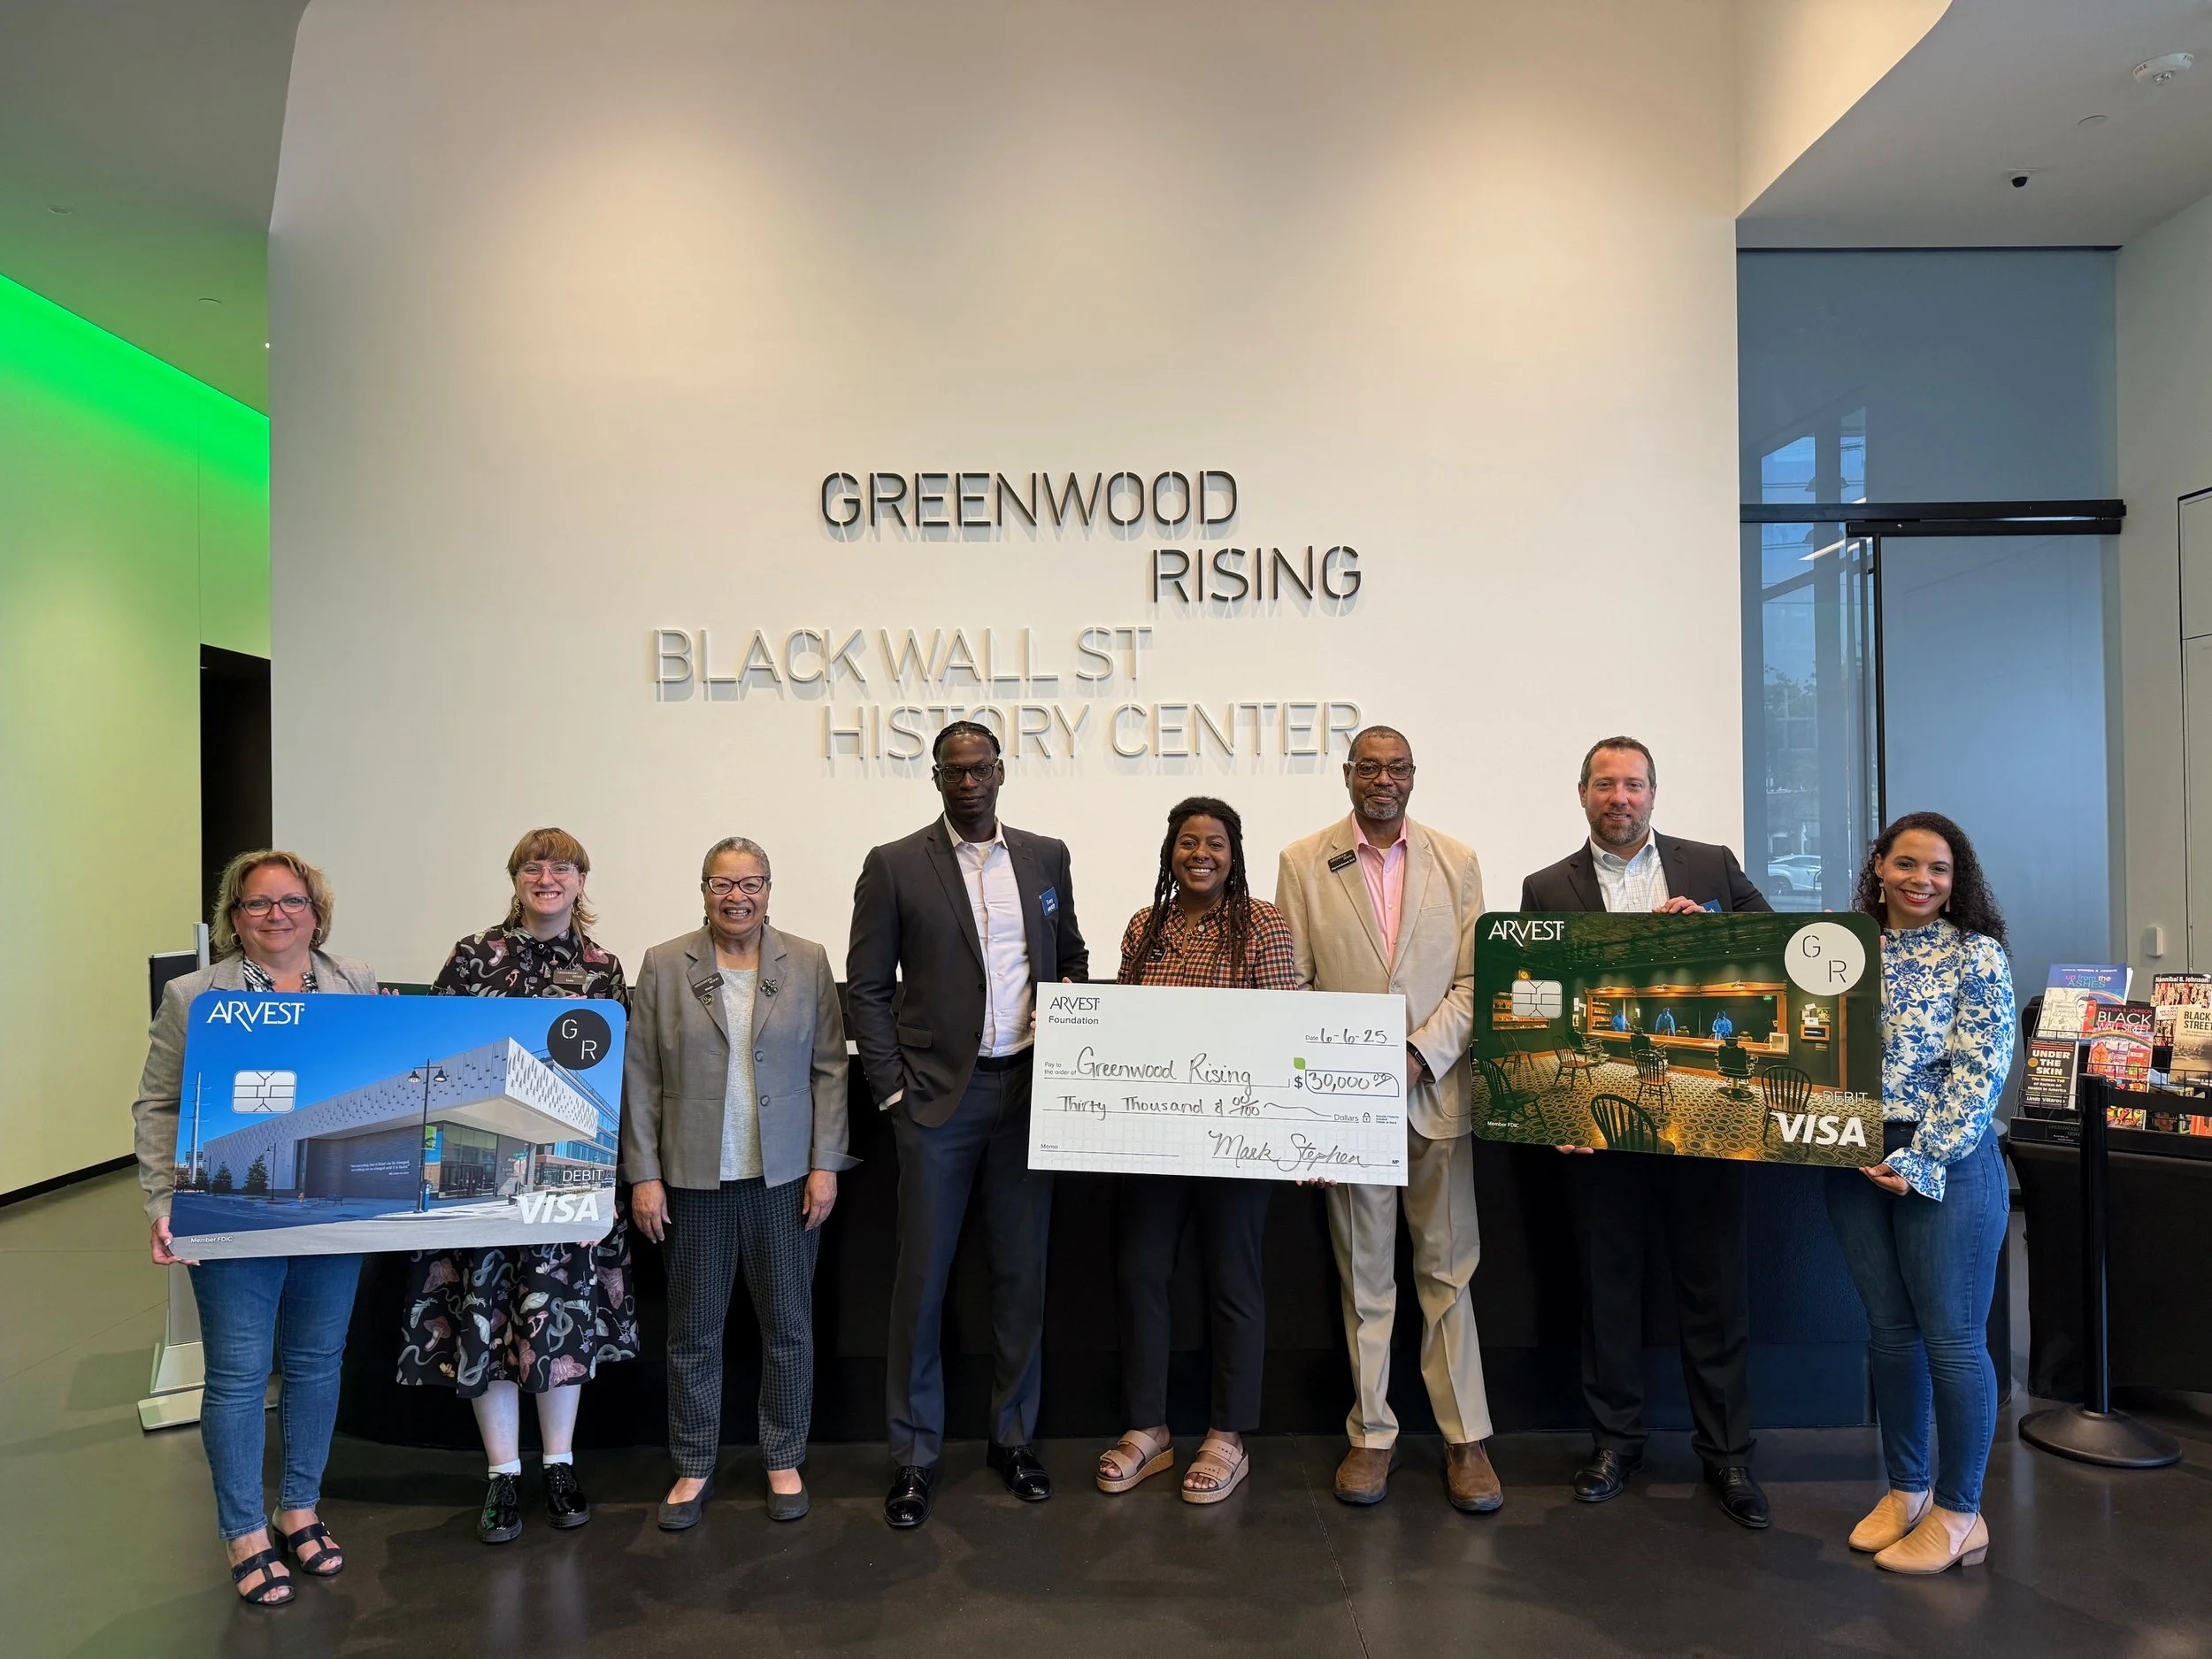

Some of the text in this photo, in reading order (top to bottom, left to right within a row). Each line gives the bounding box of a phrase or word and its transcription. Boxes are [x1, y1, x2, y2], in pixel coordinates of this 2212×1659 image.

[822, 471, 1237, 526] GREENWOOD
[1153, 546, 1361, 602] RISING
[654, 626, 1152, 682] BLACK WALL ST
[1112, 703, 1362, 757] CENTER
[1487, 919, 1564, 947] ARVEST
[1802, 935, 1821, 958] G
[1828, 960, 1847, 983] R
[2067, 979, 2106, 988] ASHES
[1049, 996, 1100, 1014] ARVEST
[205, 1000, 304, 1033] ARVEST
[1048, 1015, 1099, 1025] Foundation
[2097, 1011, 2153, 1026] BLACK
[2184, 1011, 2210, 1021] BLACK
[561, 1019, 578, 1039] G
[2097, 1022, 2151, 1034] WALL STREET
[581, 1041, 596, 1060] R
[2032, 1049, 2071, 1059] UNDER
[1077, 1046, 1251, 1096] Greenwood Rising
[2036, 1066, 2062, 1076] SKIN
[2039, 1058, 2062, 1067] THE
[1294, 1075, 1303, 1089] $
[1309, 1071, 1370, 1092] 30,000
[1823, 1090, 1868, 1104] DEBIT
[1056, 1095, 1106, 1121] Thirty
[1121, 1096, 1203, 1114] Thousand
[1333, 1113, 1359, 1122] Dollars
[1769, 1111, 1867, 1148] VISA
[563, 1169, 603, 1182] DEBIT
[511, 1194, 599, 1225] VISA
